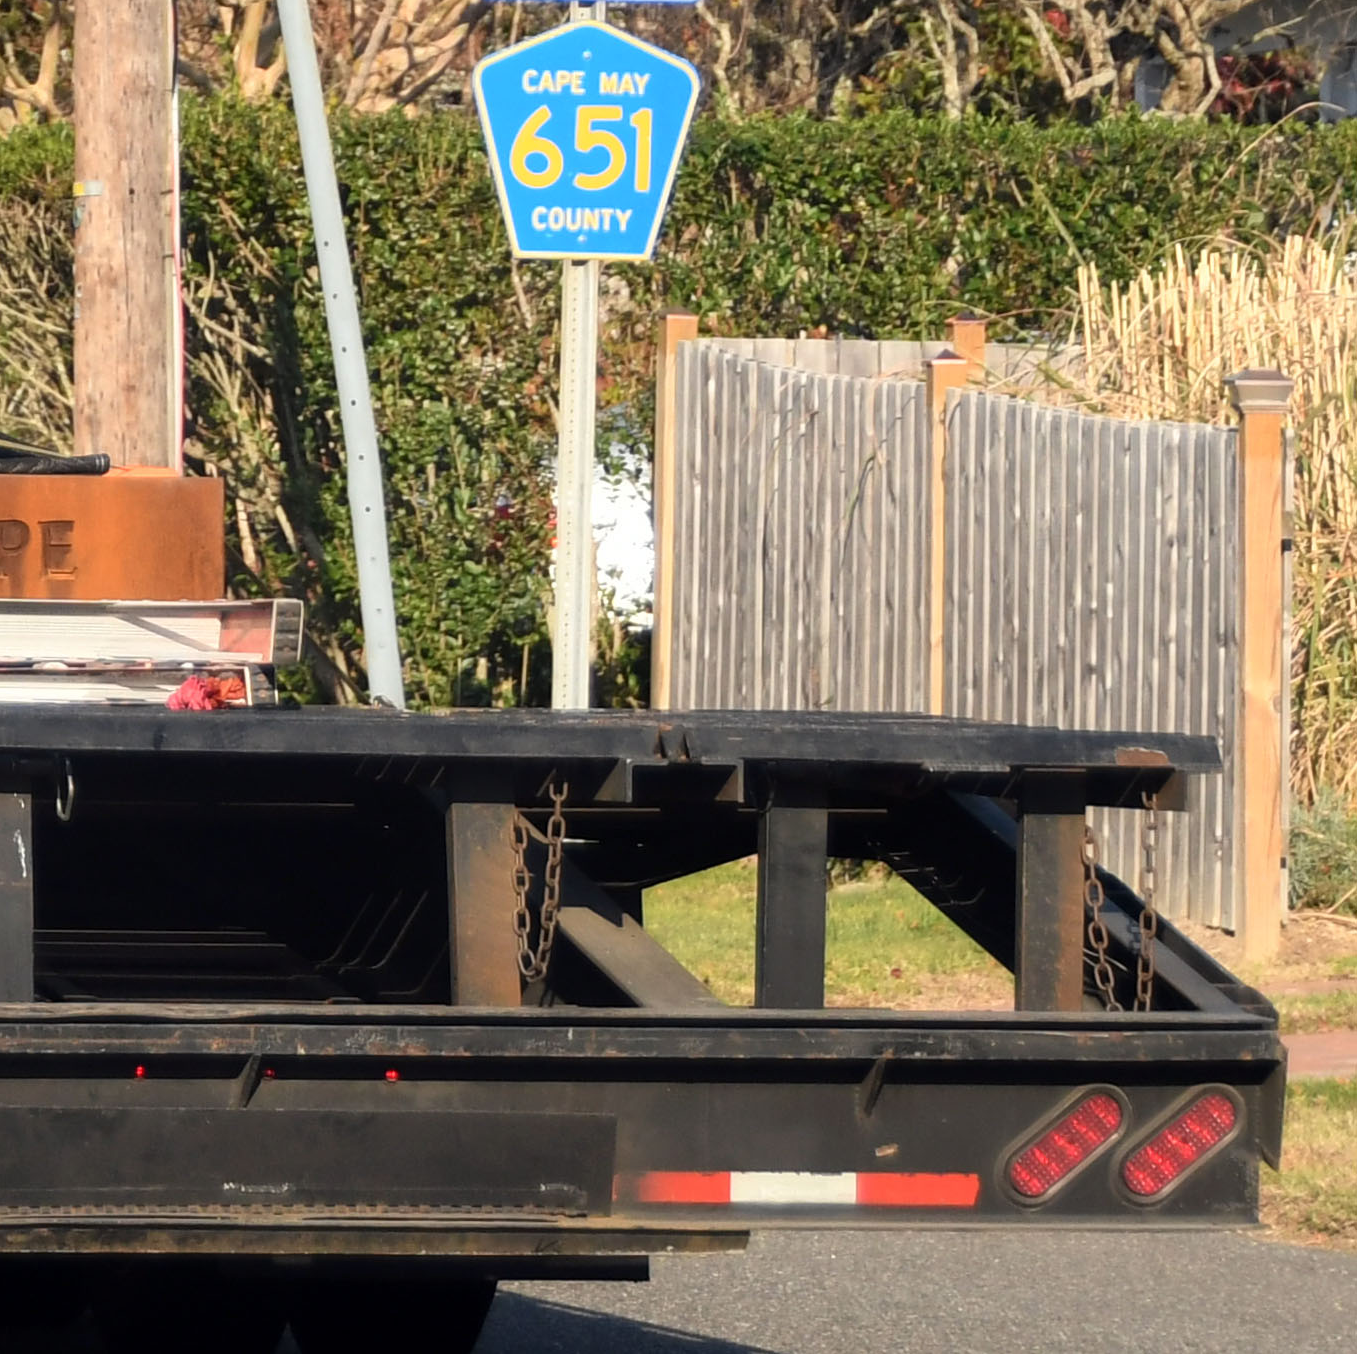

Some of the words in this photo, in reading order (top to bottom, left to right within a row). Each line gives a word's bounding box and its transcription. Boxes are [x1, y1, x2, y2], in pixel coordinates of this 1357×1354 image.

[521, 69, 587, 95] CAPE
[599, 72, 652, 96] MAY
[509, 104, 654, 194] 651
[531, 205, 634, 232] COUNTY
